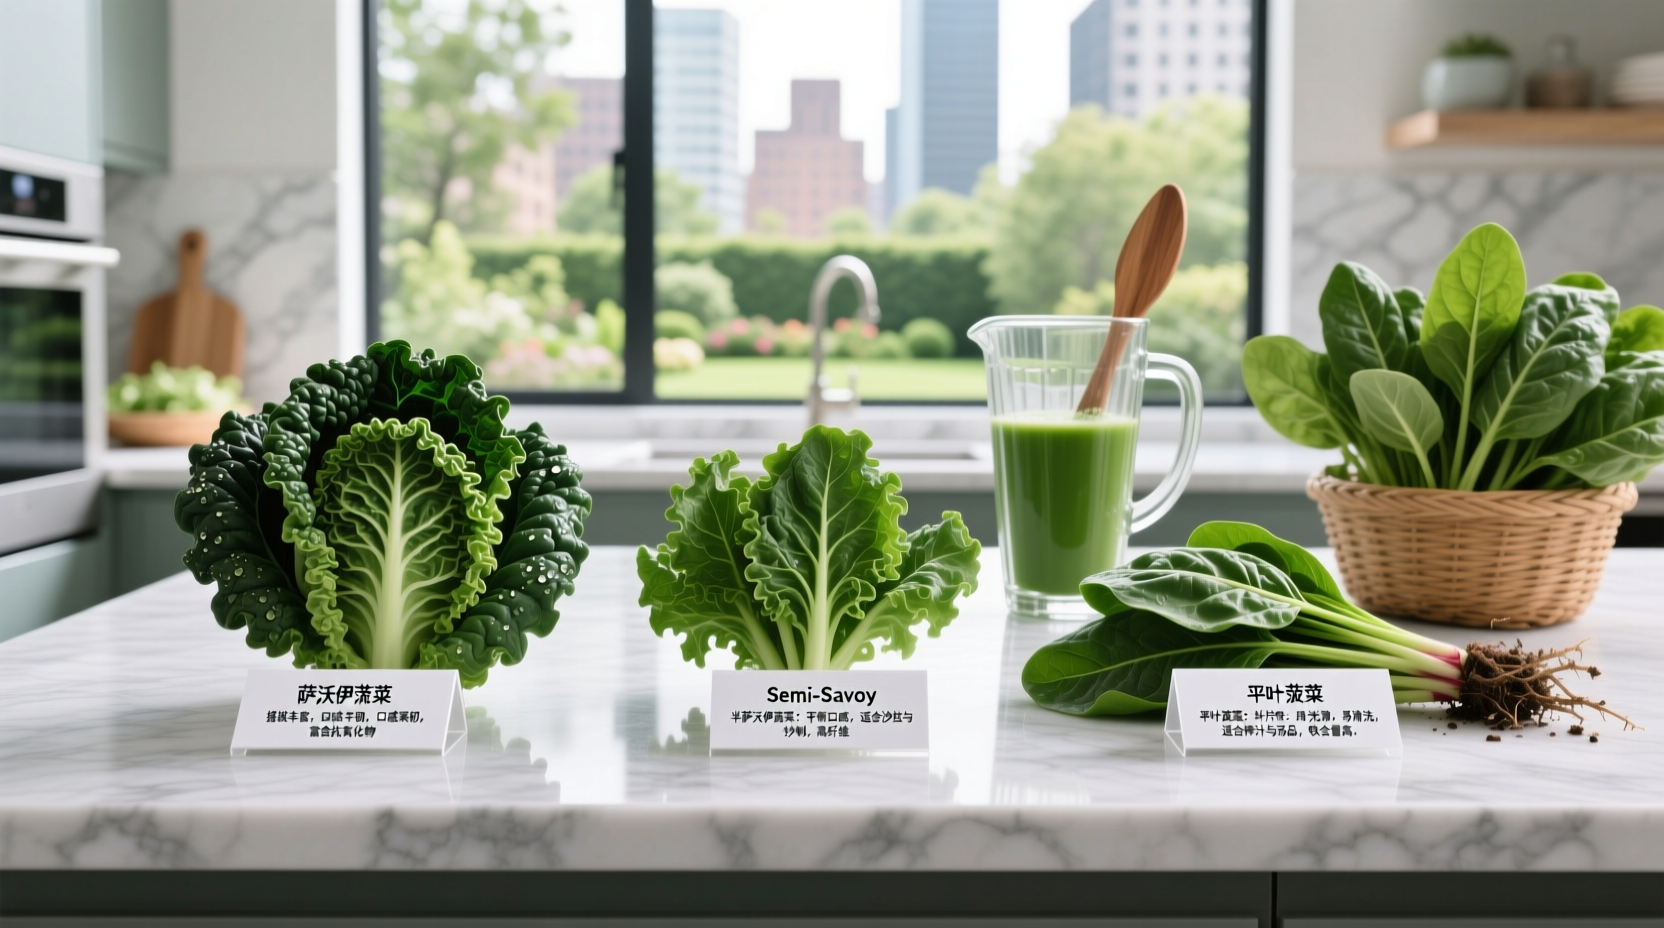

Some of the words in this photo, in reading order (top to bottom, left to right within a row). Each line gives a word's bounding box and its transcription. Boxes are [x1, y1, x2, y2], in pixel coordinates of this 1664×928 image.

[766, 686, 877, 706] Semi-Savoy
[1246, 682, 1325, 704] 平叶菠菜
